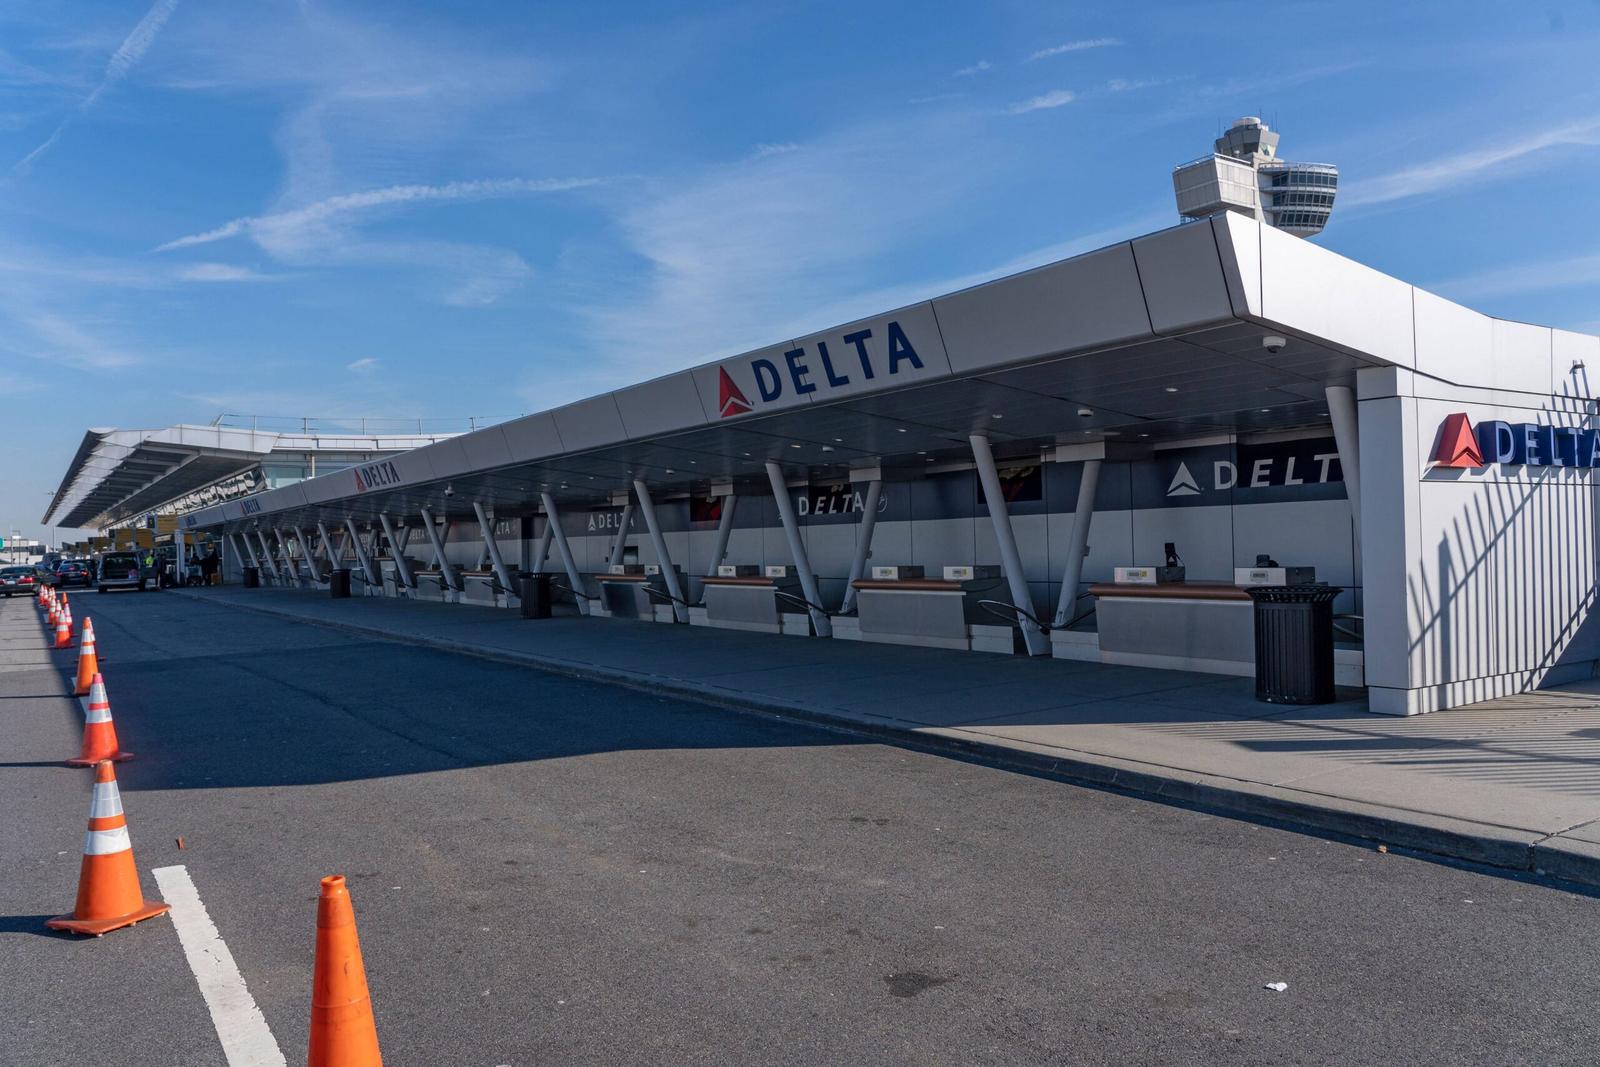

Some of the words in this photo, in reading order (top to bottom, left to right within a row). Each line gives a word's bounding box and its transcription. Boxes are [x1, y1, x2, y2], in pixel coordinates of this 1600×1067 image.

[751, 321, 925, 402] DELTA
[362, 461, 401, 488] DELTA
[1214, 453, 1340, 490] DELT
[798, 491, 865, 516] DELTA
[598, 512, 635, 529] DEL
